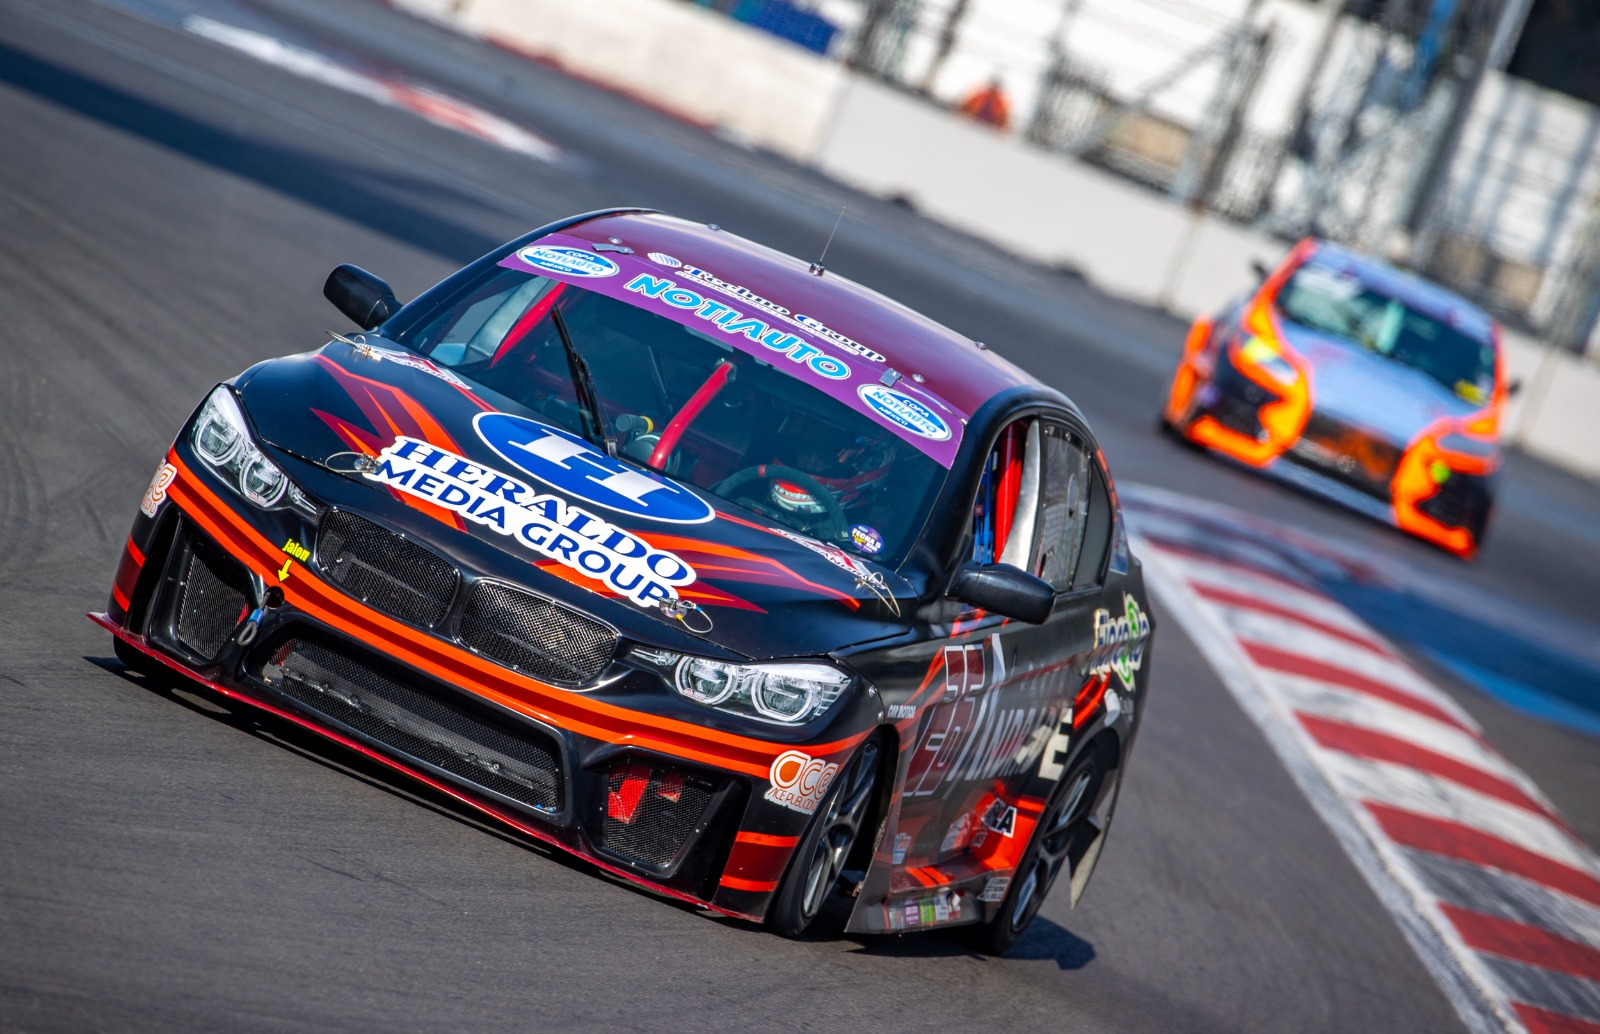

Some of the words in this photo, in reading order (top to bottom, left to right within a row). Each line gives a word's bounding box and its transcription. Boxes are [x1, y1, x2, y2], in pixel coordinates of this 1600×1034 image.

[533, 250, 604, 272] NOTIAUTO
[565, 251, 595, 261] COPA
[625, 274, 850, 378] NOTIAUTO
[683, 264, 790, 314] Techno
[794, 314, 886, 362] Group
[873, 391, 937, 433] NOTIAUTO
[902, 399, 930, 418] COPA
[507, 428, 680, 507] H
[375, 459, 505, 529] MEDIA
[521, 522, 670, 602] GROUP
[394, 440, 688, 581] HERALDO
[281, 538, 310, 562] jalon
[767, 787, 786, 802] ACE
